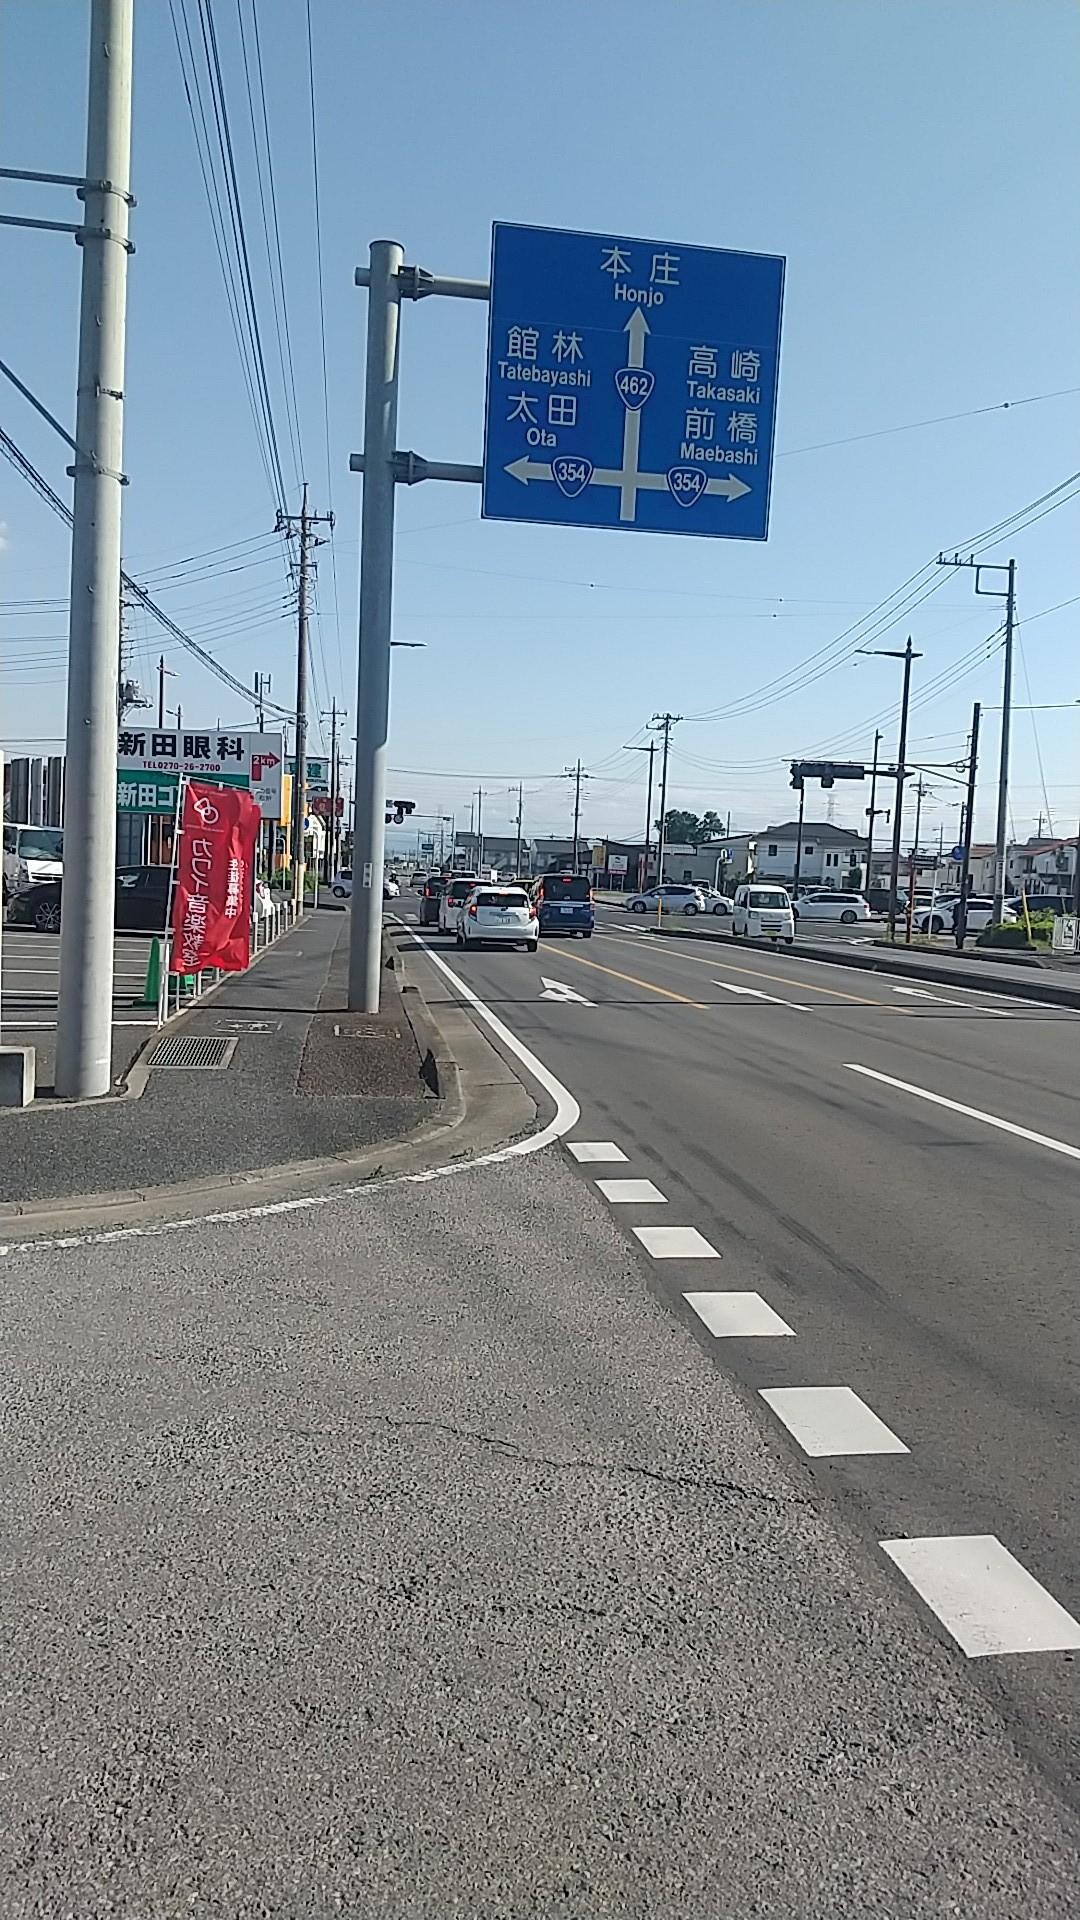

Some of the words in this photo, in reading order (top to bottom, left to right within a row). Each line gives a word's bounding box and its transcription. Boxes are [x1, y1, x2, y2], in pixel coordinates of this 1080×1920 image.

[600, 246, 681, 285] 本庄
[614, 282, 664, 307] Honjo
[506, 325, 584, 364] 館林
[498, 361, 591, 387] Tatebayashi
[688, 345, 761, 382] 高崎
[620, 375, 649, 395] 462
[686, 380, 761, 404] Takasaki
[506, 391, 577, 426] 太田
[526, 427, 557, 447] Ota
[684, 406, 758, 444] 前橋
[680, 442, 758, 465] Maebashi
[558, 462, 586, 482] 354
[673, 472, 701, 492] 354
[118, 731, 245, 761] 新田眼科
